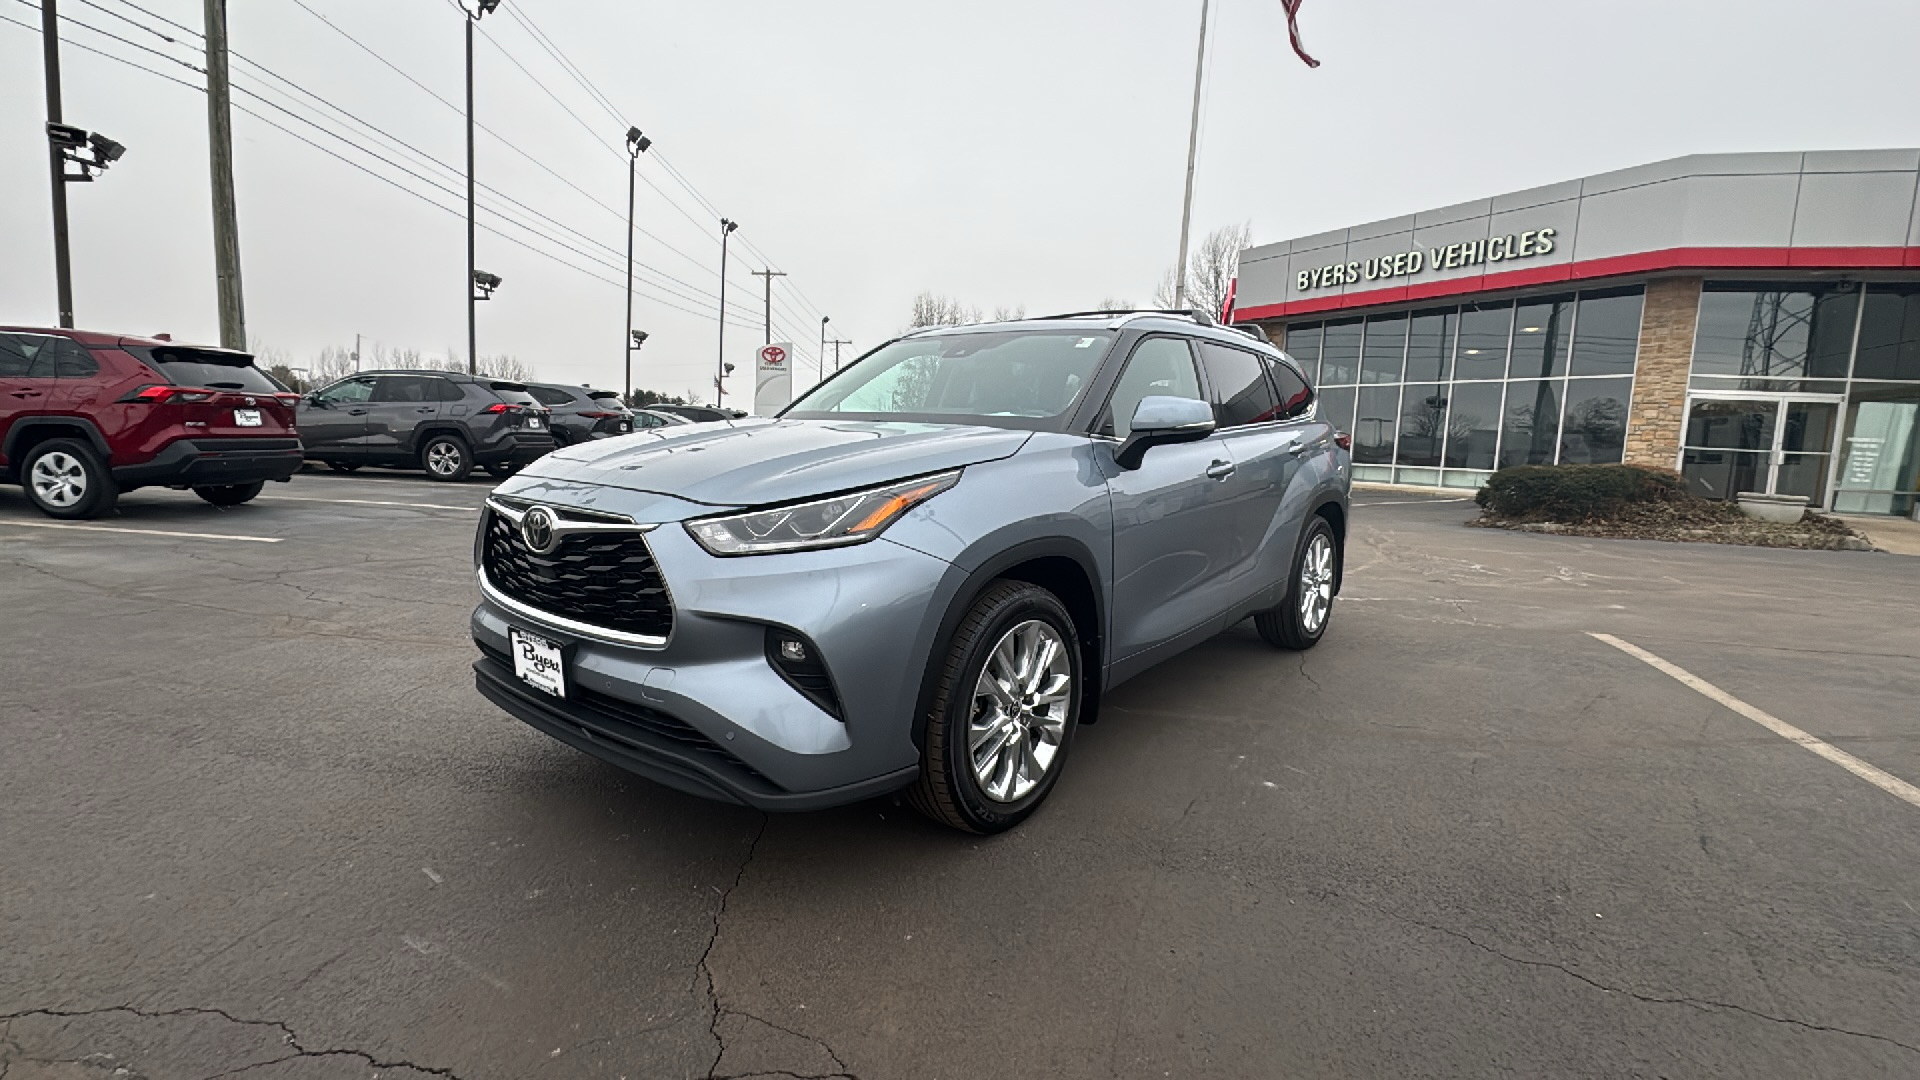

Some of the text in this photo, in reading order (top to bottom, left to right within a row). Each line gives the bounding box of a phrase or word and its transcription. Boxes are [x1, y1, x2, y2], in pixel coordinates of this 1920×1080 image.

[1297, 228, 1555, 290] BYERS USED VEHICLES
